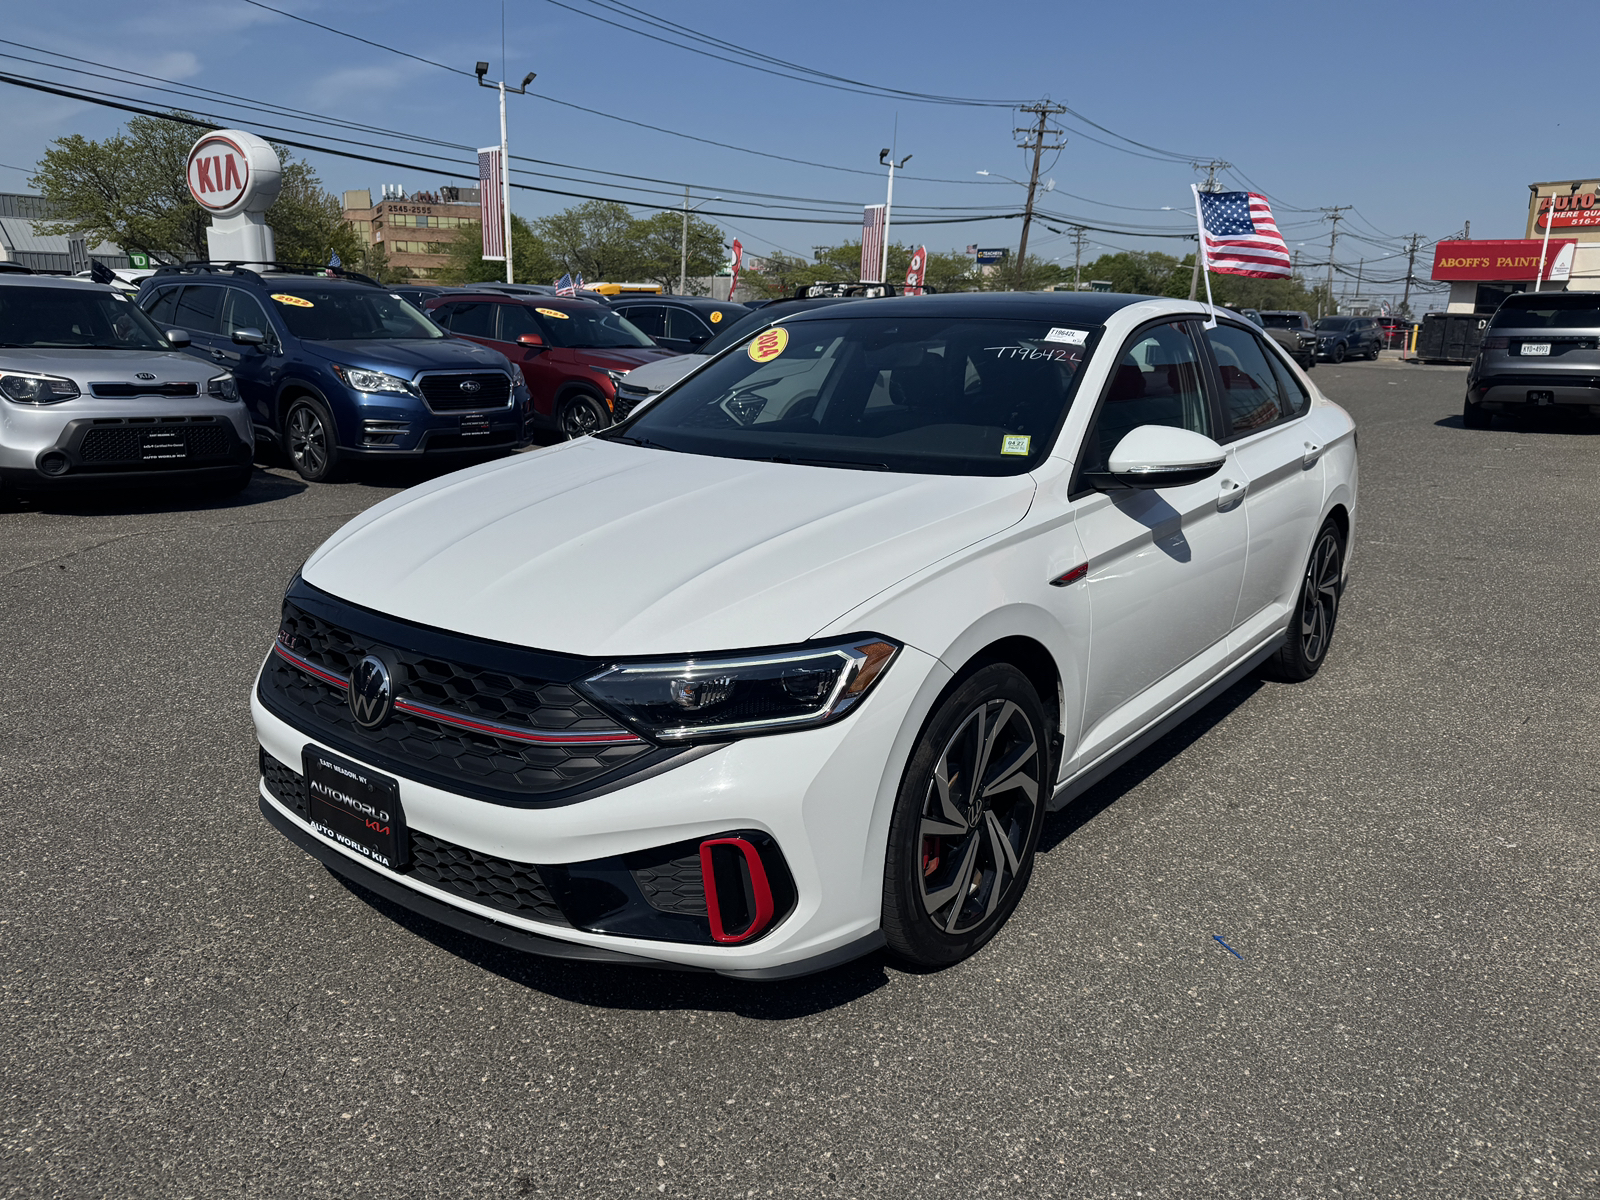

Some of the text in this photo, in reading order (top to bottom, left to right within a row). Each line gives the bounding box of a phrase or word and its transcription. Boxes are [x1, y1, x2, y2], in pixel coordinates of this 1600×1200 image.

[196, 153, 242, 194] KIA
[388, 205, 432, 214] 2545-2555
[1540, 194, 1595, 210] AUTO
[131, 255, 146, 266] TD
[1438, 257, 1490, 268] ABOFF'S
[1050, 329, 1076, 337] T19642L
[758, 330, 779, 359] 2024
[984, 346, 1082, 362] T19642L
[319, 758, 333, 769] EAST
[310, 780, 389, 822] AUTOWORLD
[310, 821, 390, 866] AUTO WORLD KIA
